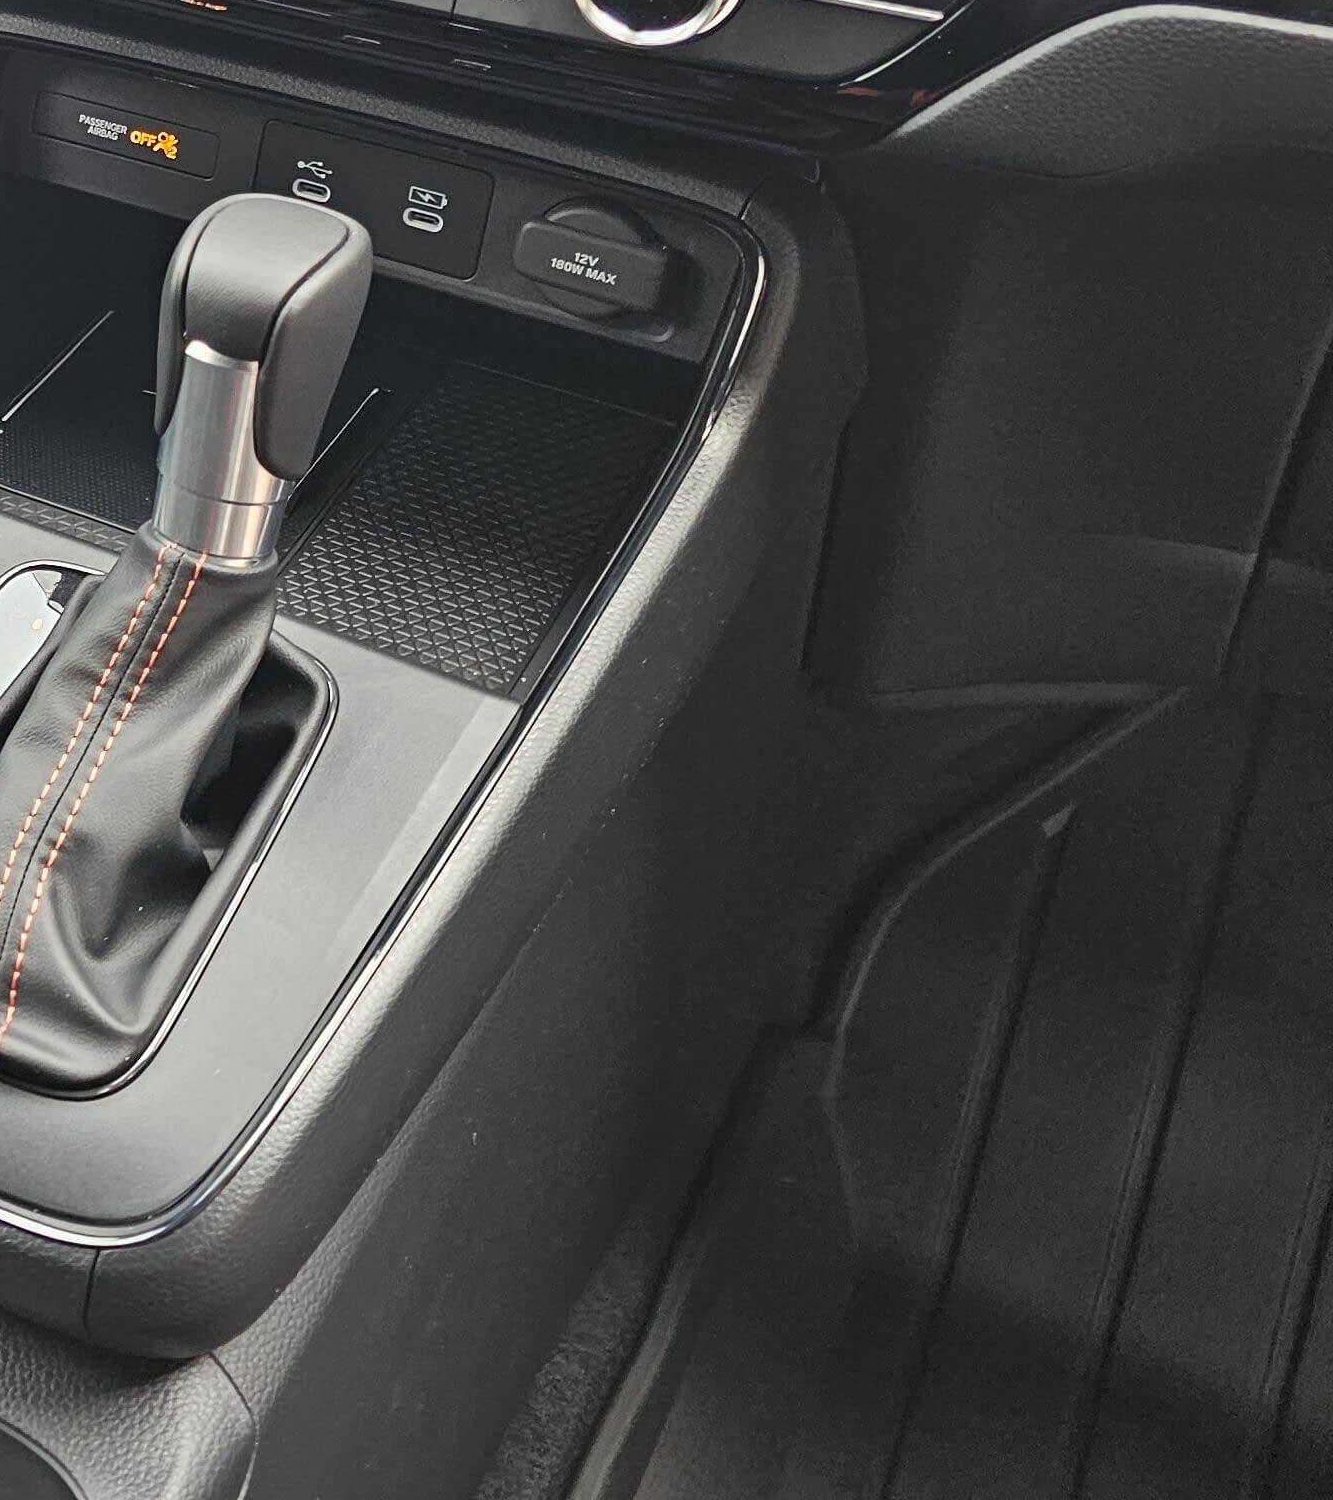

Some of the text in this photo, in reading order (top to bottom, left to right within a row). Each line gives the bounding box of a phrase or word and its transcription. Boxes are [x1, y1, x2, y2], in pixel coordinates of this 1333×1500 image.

[78, 114, 128, 135] PASSENGER
[87, 125, 119, 141] AIRBAG
[130, 130, 158, 147] OFF
[574, 252, 600, 267] 12V
[551, 257, 618, 286] 180W MAX
